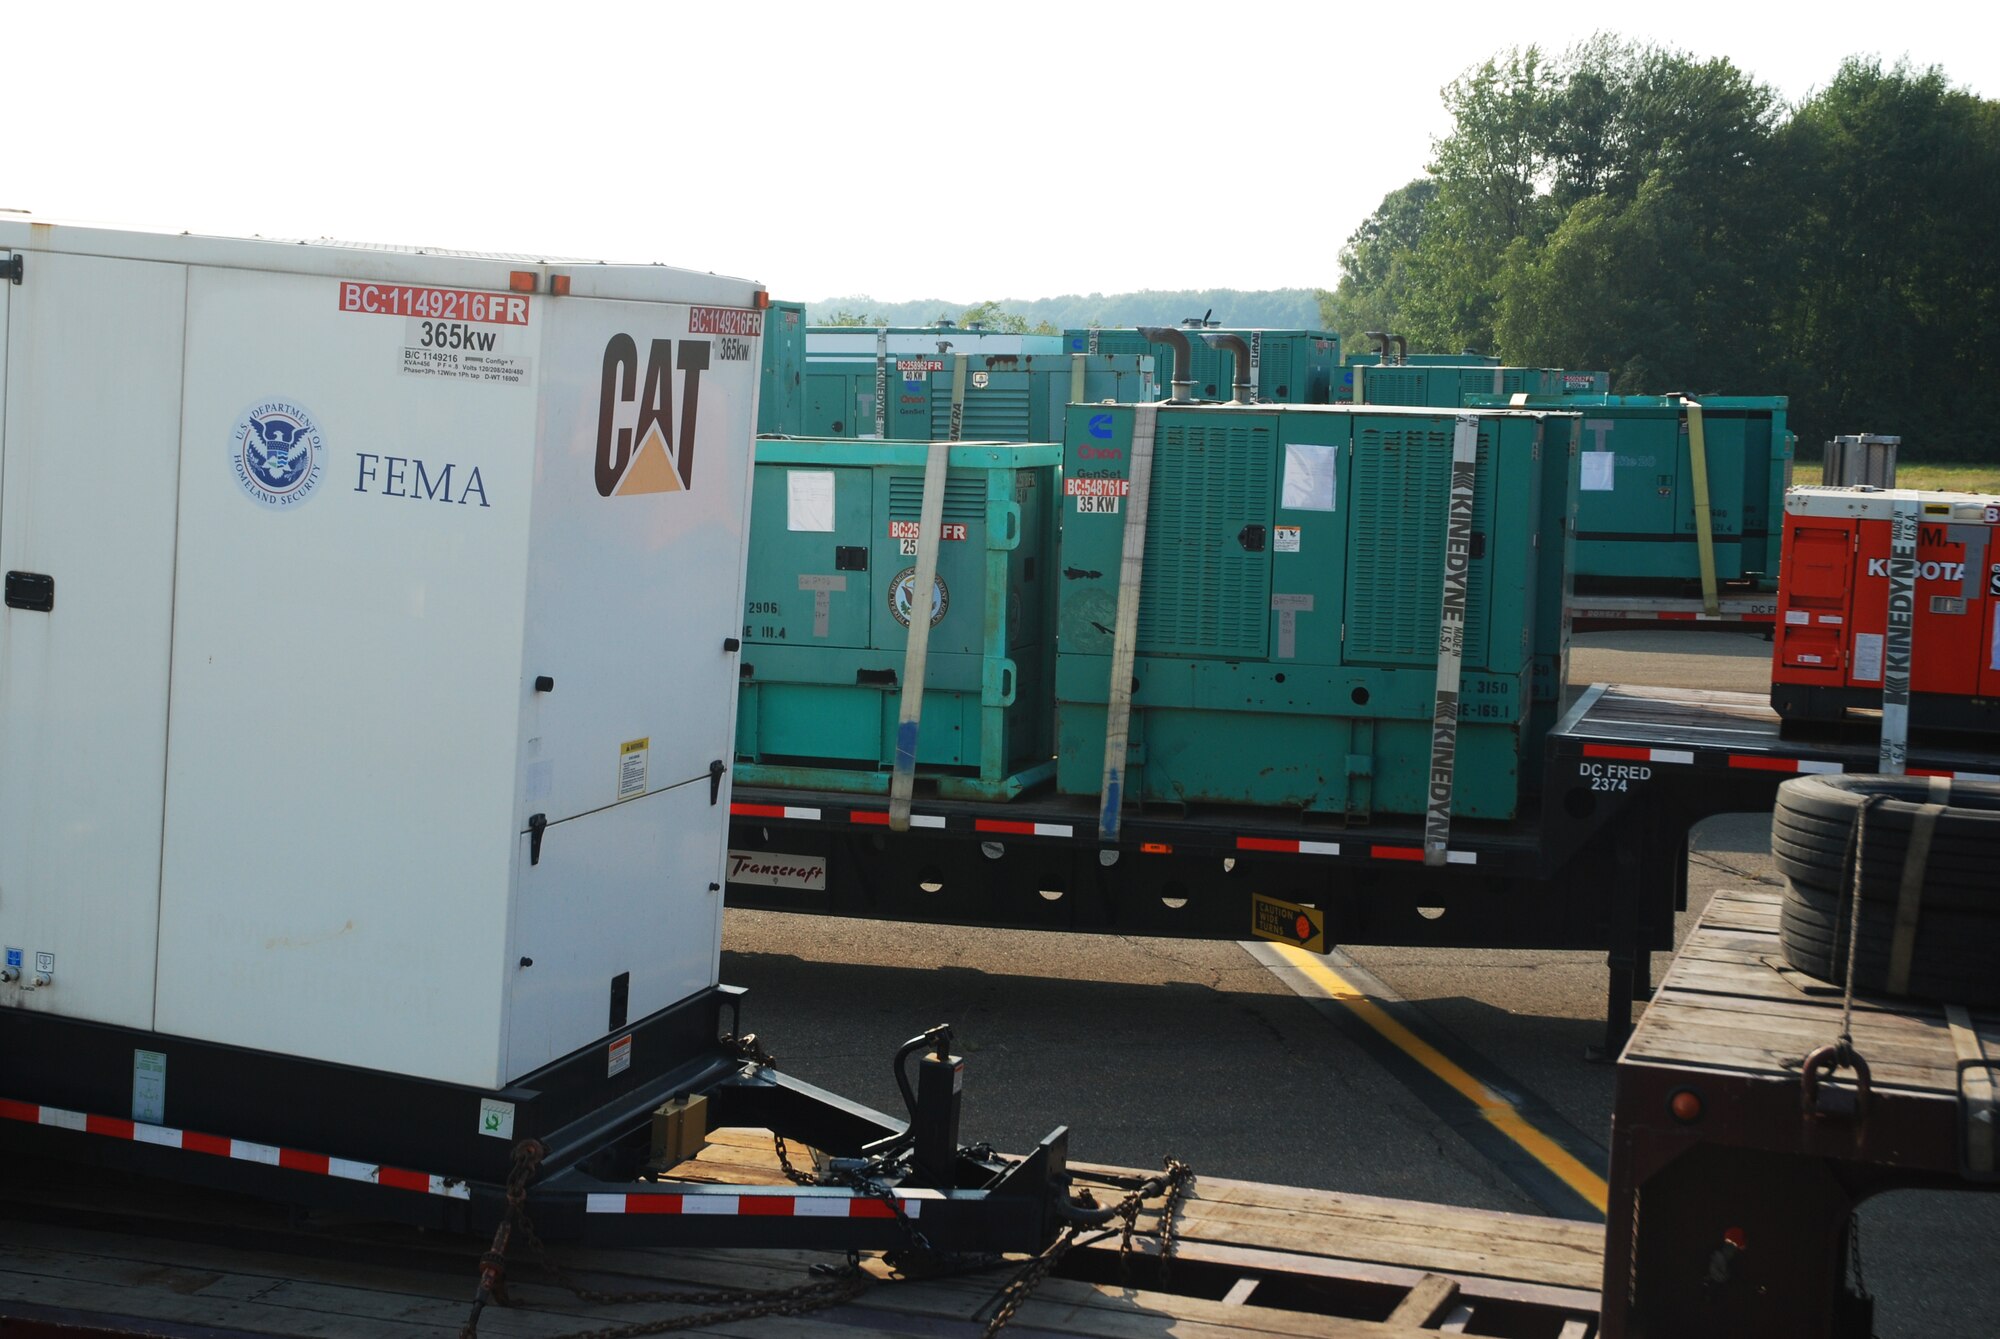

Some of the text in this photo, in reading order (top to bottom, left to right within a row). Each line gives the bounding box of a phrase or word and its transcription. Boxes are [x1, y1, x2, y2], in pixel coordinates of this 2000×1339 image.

[345, 284, 527, 323] BC:1149216FR
[691, 308, 761, 334] BC:1149216FR
[420, 321, 497, 352] 365kw
[405, 351, 420, 360] B/C
[423, 352, 458, 363] 1149216
[720, 338, 750, 361] 365kw
[876, 367, 886, 421] KINEDYNE
[595, 333, 711, 497] CAT
[252, 403, 317, 434] DEPARTMENT
[312, 435, 322, 451] OF
[234, 454, 321, 505] HOMELAND SECURITY
[354, 452, 491, 508] FEMA
[1077, 468, 1121, 479] GenSet
[1067, 479, 1129, 495] BC:548761F
[1080, 496, 1116, 513] 35 KW
[903, 539, 916, 555] 25
[1443, 494, 1473, 623] KINEDYNE
[748, 602, 778, 614] 2906
[1886, 545, 1916, 673] KINEDYNE
[1477, 680, 1509, 694] 3150
[1580, 762, 1652, 780] DC FRED
[1591, 777, 1628, 792] 2374
[729, 855, 824, 883] Transcraft
[1259, 903, 1294, 920] CAUTION
[1260, 911, 1279, 924] WIDE
[1259, 921, 1284, 936] TURNS
